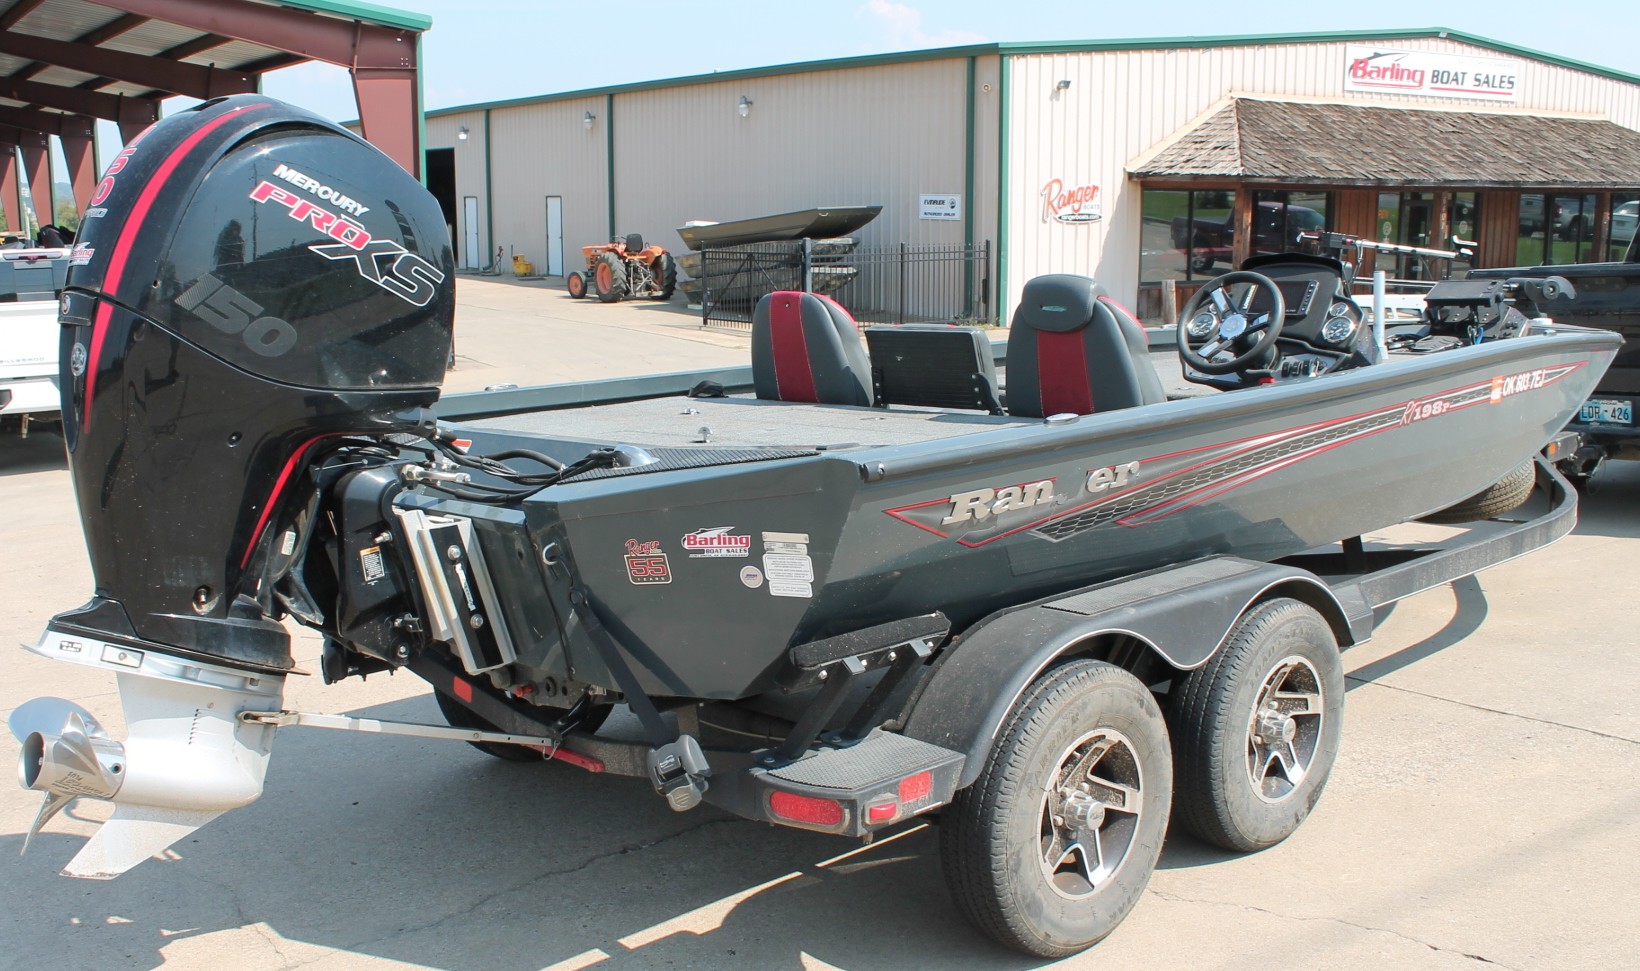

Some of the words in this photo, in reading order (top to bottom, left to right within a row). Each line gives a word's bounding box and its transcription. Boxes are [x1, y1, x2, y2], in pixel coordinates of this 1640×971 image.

[1351, 58, 1425, 86] Barling
[1430, 69, 1467, 86] BOAT
[1473, 73, 1516, 90] SALES
[272, 163, 370, 217] MERCURY
[1041, 178, 1099, 216] Ranger
[249, 180, 372, 251] PRO
[307, 239, 446, 307] XS
[174, 272, 298, 357] 150
[1502, 375, 1517, 397] OK
[624, 538, 660, 557] Ranger
[685, 533, 750, 548] Barling
[628, 557, 668, 577] 55
